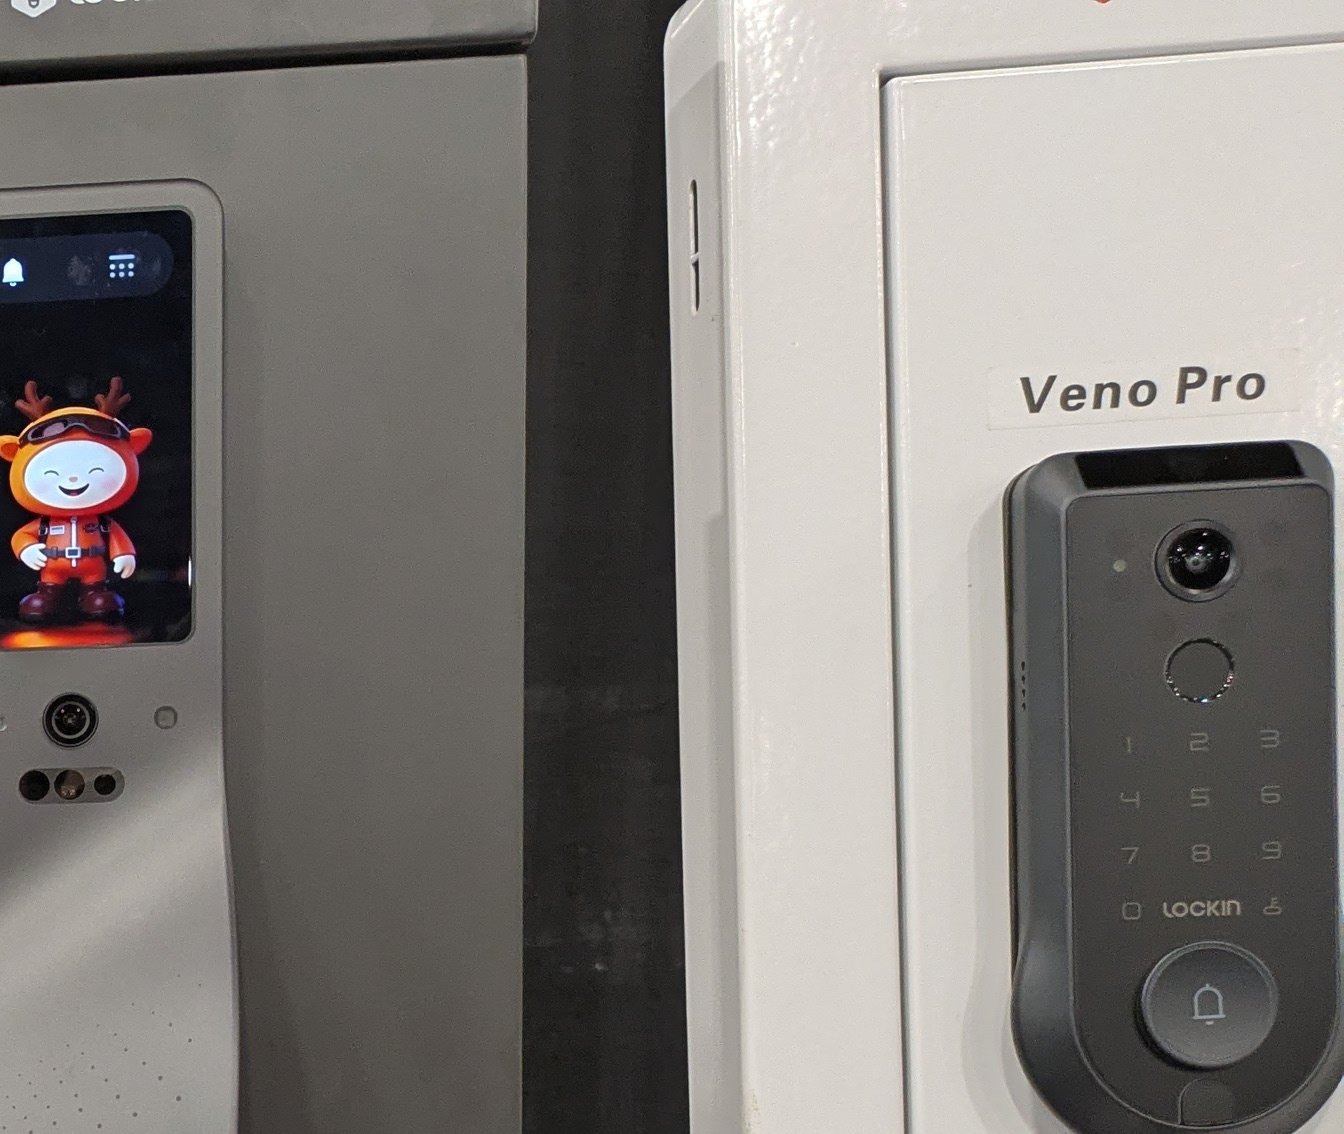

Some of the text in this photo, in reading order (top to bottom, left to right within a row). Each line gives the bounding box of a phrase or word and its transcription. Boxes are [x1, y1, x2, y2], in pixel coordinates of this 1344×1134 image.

[1019, 366, 1266, 414] Veno Pro
[1190, 732, 1209, 751] 2
[1260, 729, 1280, 748] 3
[1120, 785, 1281, 809] 4 5 6
[1120, 841, 1281, 864] 7 8 9
[1163, 900, 1241, 918] LOCKIN
